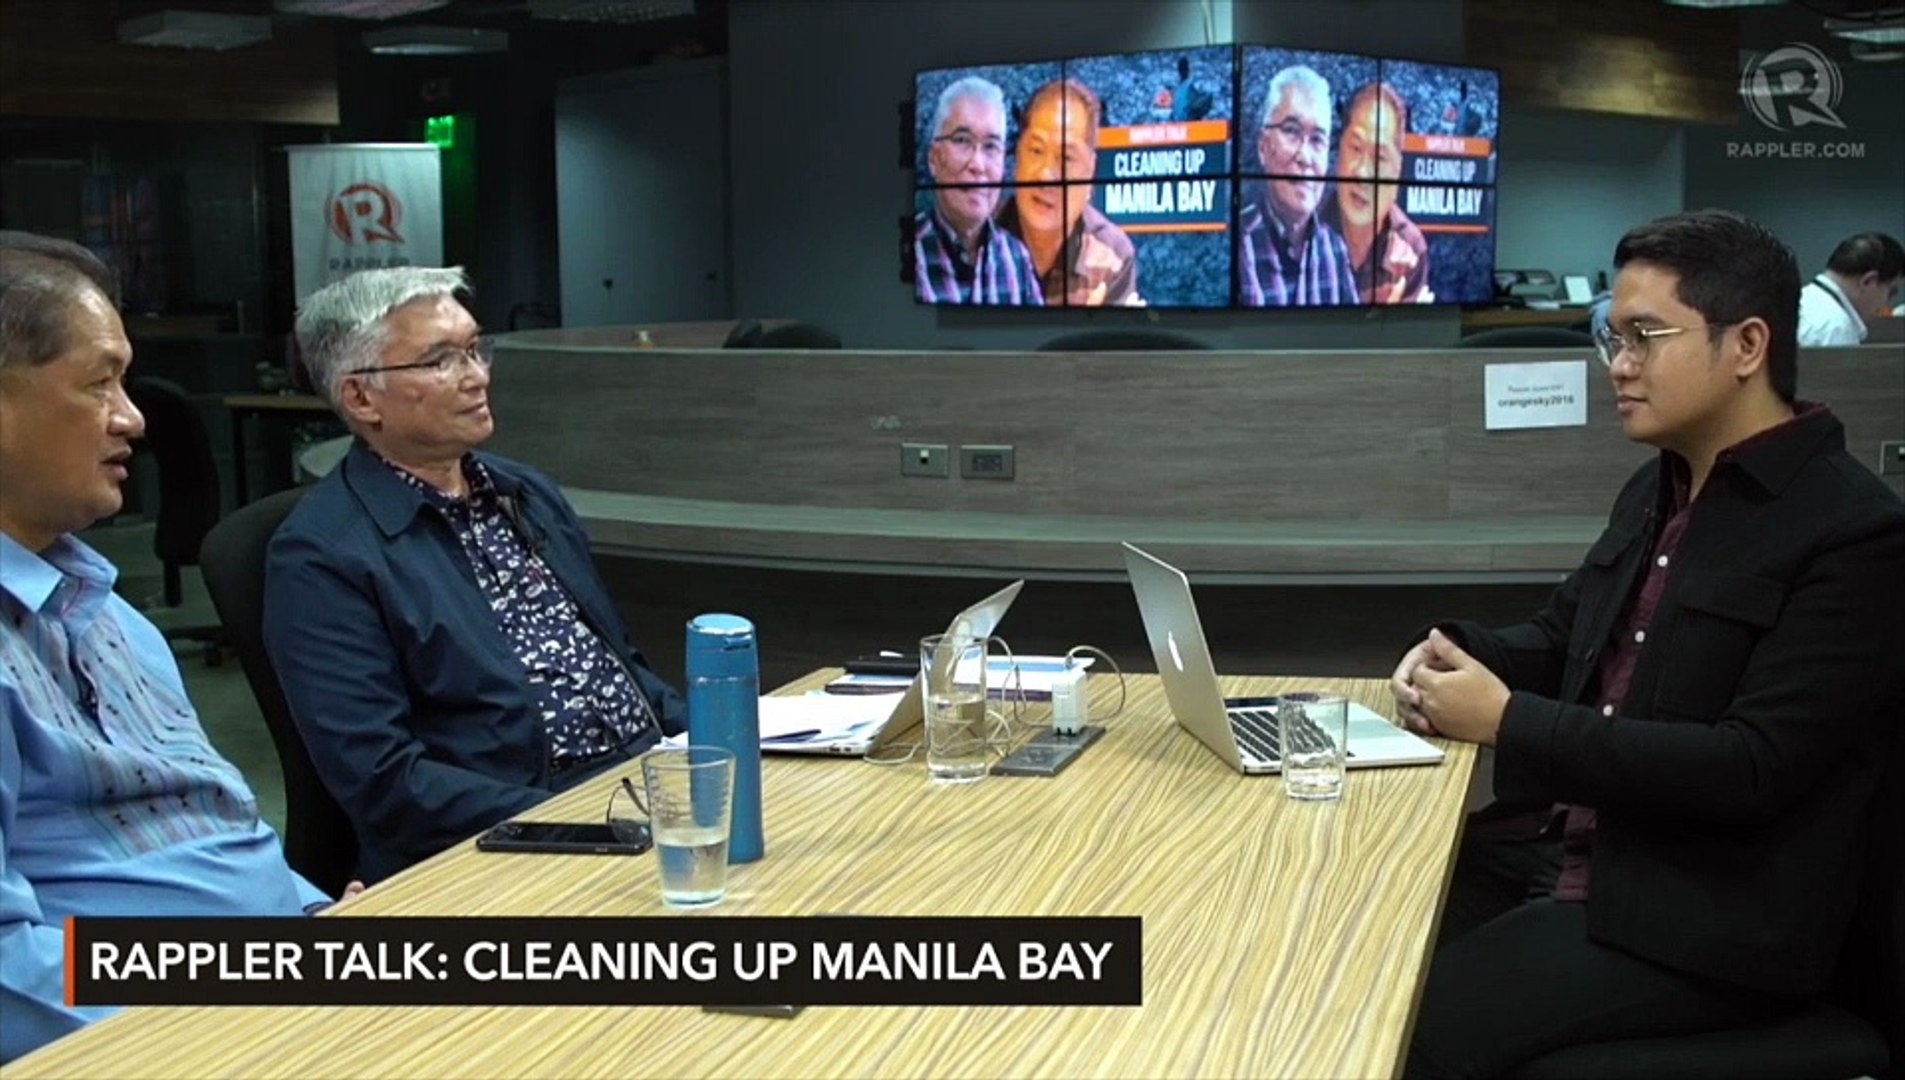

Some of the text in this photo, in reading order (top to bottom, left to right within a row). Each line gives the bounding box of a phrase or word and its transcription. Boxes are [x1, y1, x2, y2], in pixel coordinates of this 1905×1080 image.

[1114, 148, 1205, 178] CLEANING UP
[1414, 157, 1460, 182] CLEANING
[1105, 180, 1216, 214] MANILA BAY
[1407, 186, 1483, 215] MANILA BAY
